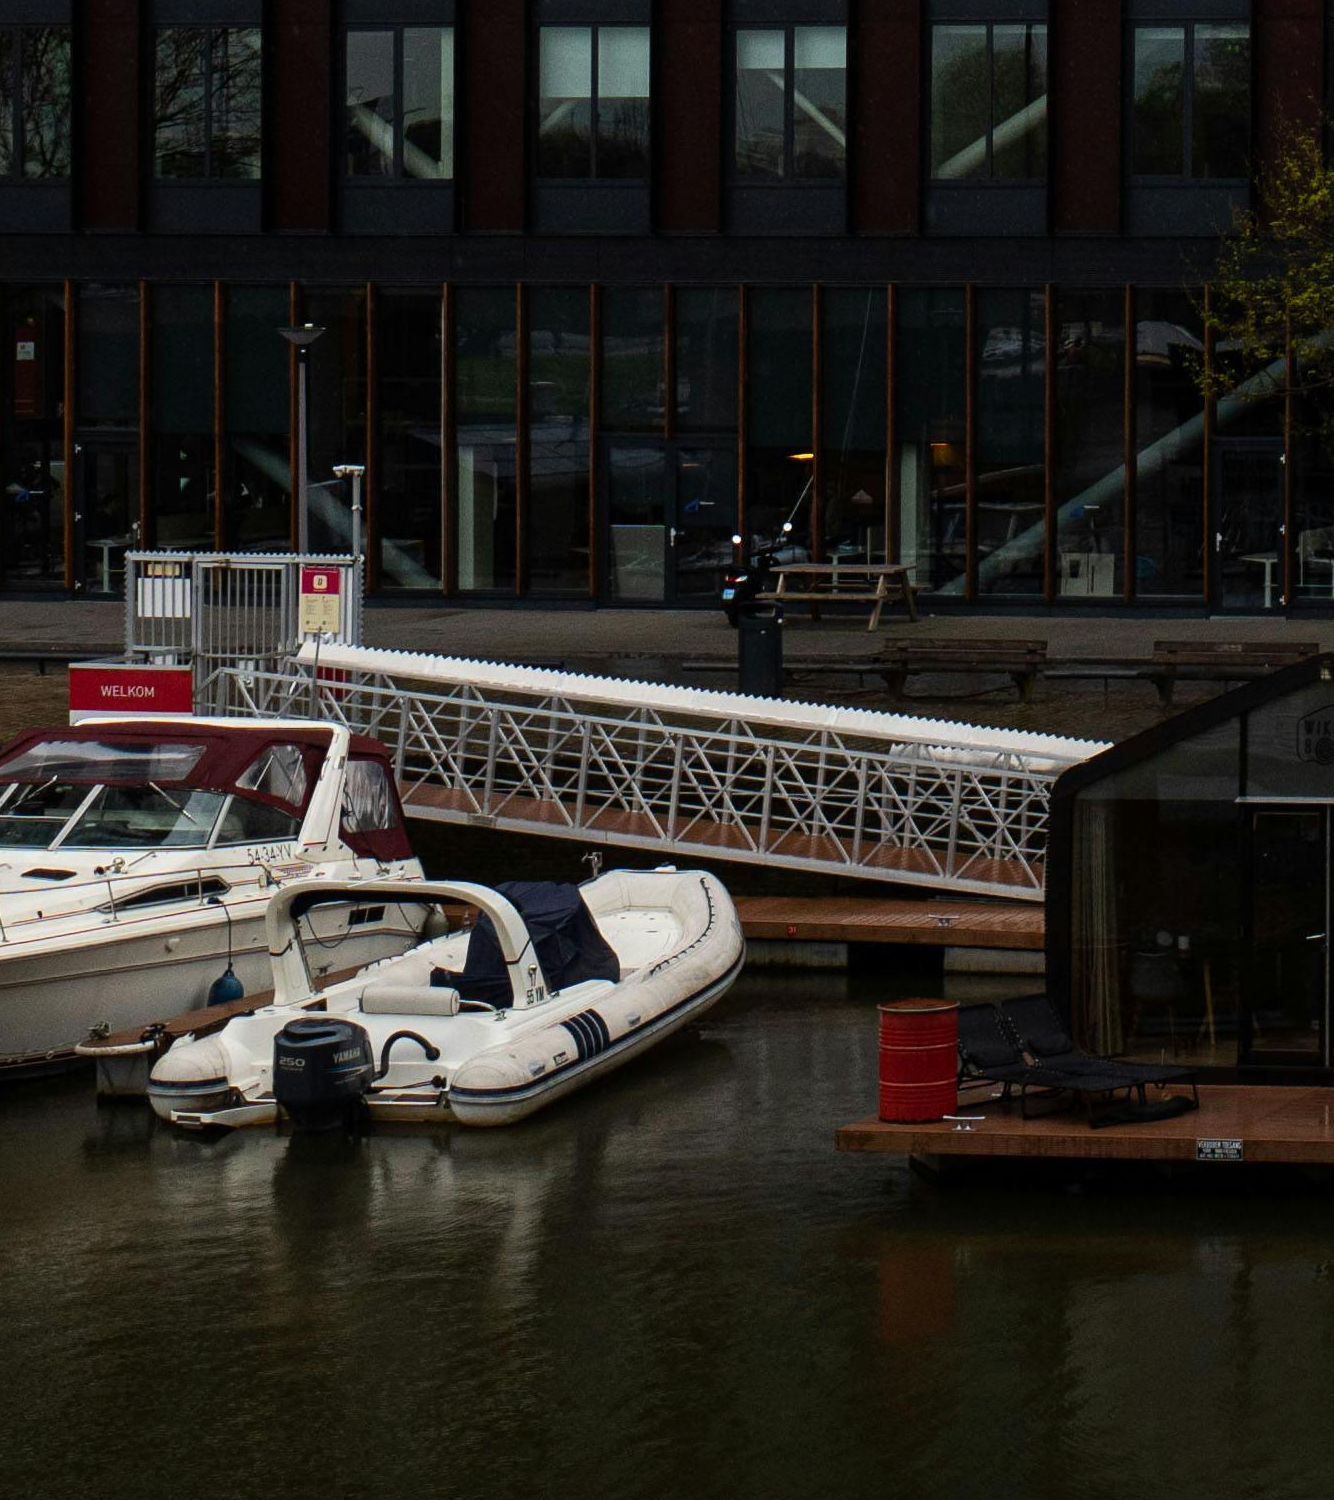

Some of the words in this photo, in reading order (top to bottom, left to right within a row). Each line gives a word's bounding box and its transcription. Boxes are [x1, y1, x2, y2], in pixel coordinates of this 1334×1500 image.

[100, 685, 155, 698] WELKOM
[278, 1056, 306, 1067] 250
[332, 1047, 361, 1064] YAMAHA
